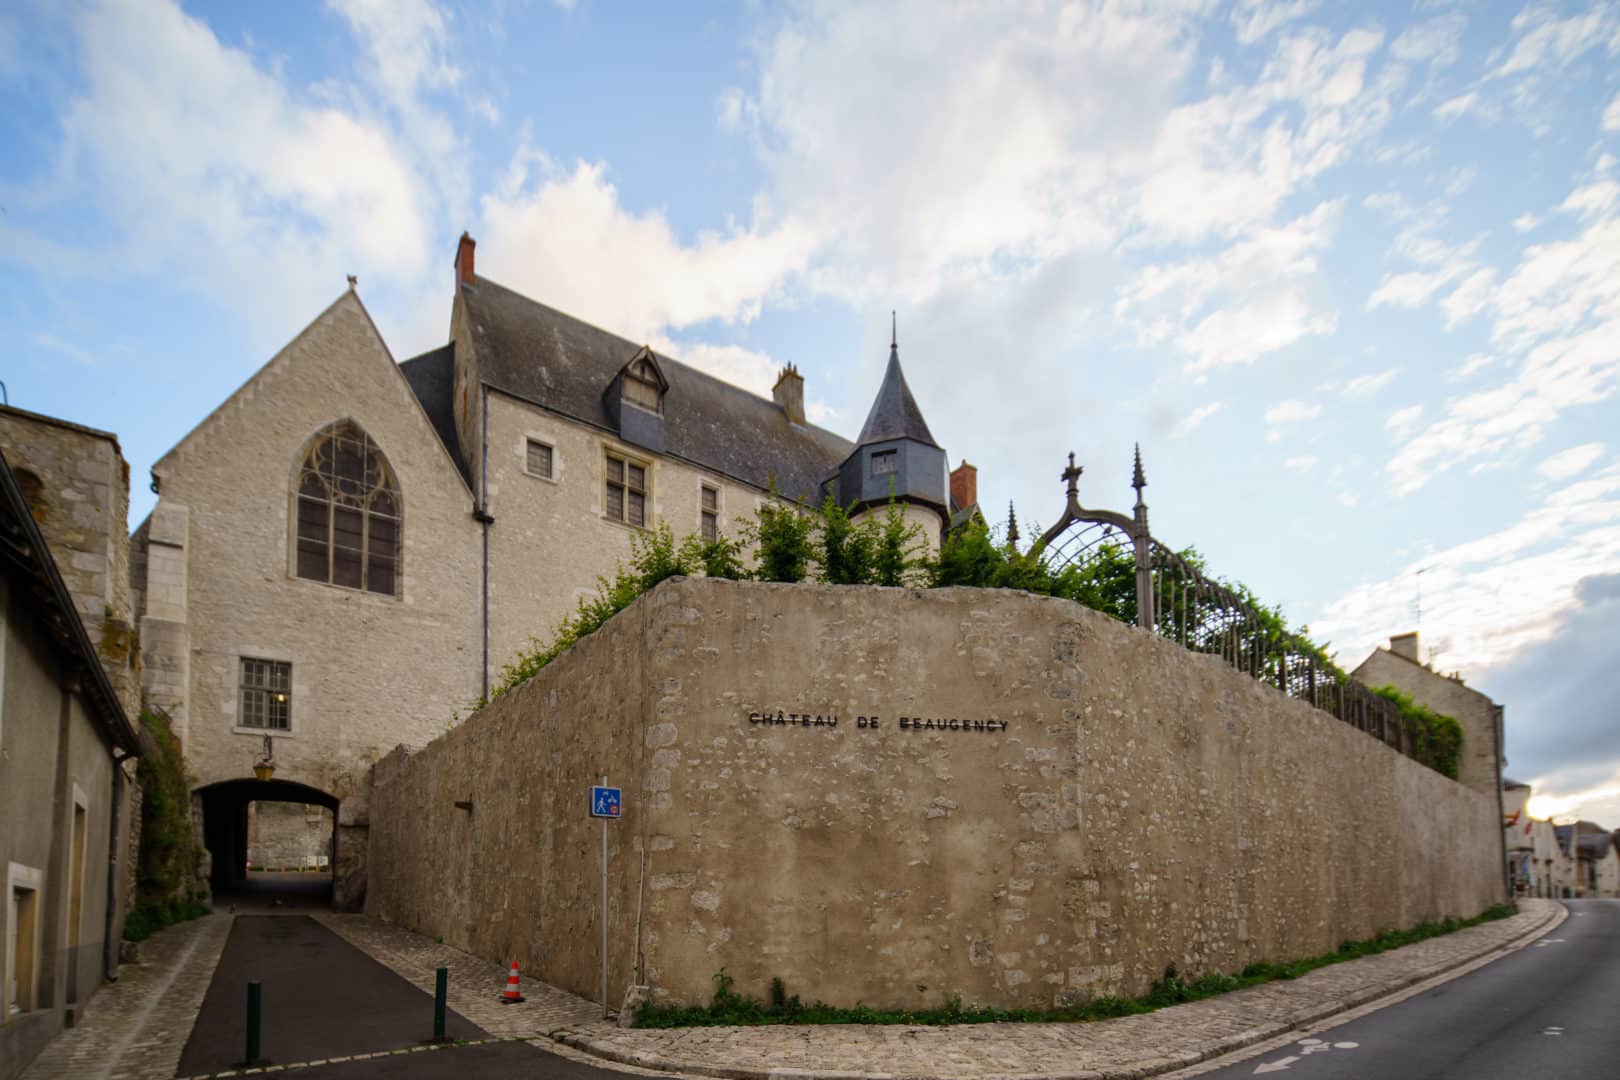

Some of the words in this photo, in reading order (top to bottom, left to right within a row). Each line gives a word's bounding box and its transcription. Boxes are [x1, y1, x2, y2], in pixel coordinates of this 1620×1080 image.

[749, 711, 838, 728] CHÂTEAU
[857, 716, 880, 729] DE
[900, 717, 1009, 732] BEAUGENCY
